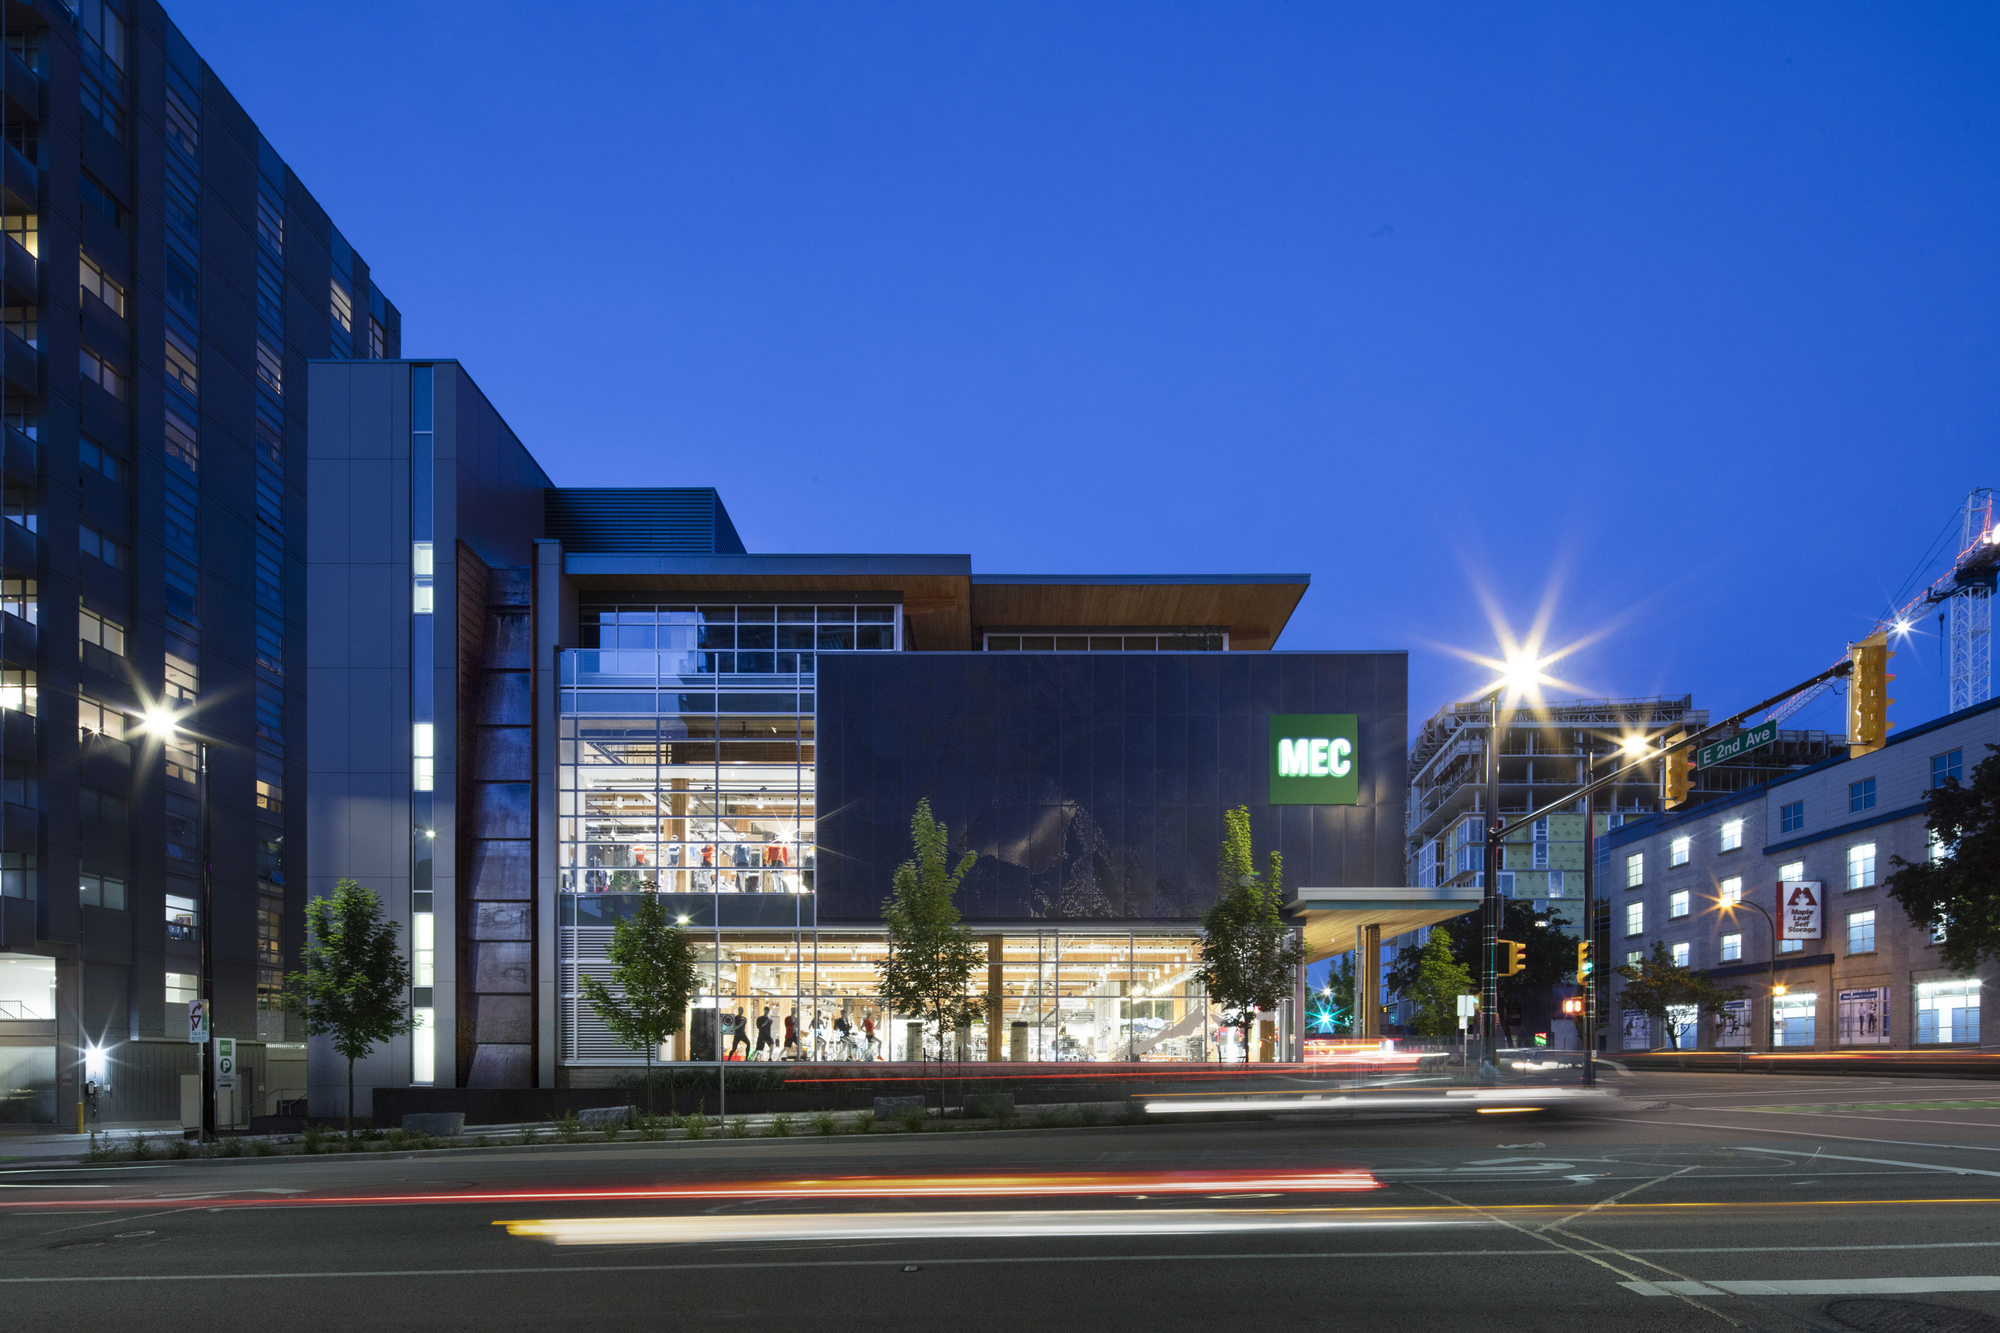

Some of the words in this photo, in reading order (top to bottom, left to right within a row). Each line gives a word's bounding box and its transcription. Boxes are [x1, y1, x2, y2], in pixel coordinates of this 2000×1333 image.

[1278, 738, 1351, 777] MEC
[1703, 749, 1711, 764] E
[1717, 738, 1740, 759] 2nd
[1746, 729, 1770, 748] Ave
[222, 1060, 230, 1072] P
